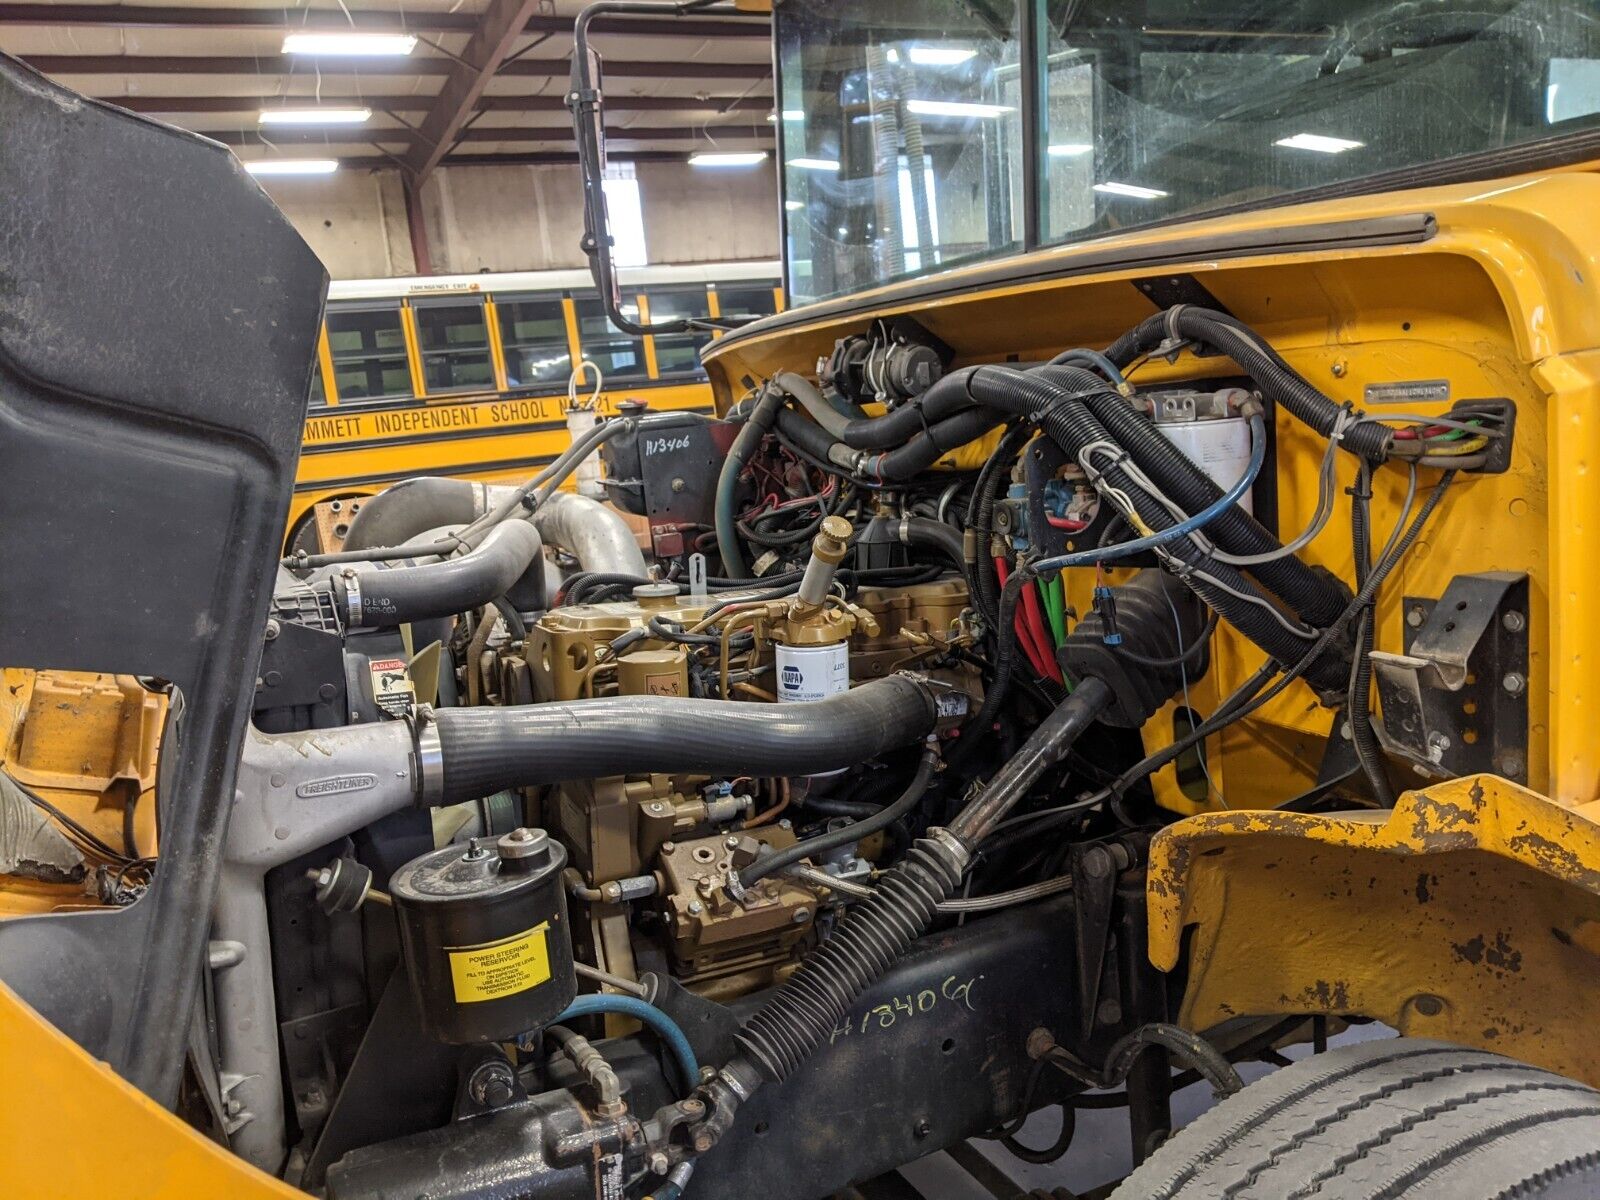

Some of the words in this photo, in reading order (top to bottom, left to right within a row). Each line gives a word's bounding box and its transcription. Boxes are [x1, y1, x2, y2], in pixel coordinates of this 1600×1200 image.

[303, 417, 361, 440] MMETT
[374, 406, 478, 433] INDEPENDENT
[491, 401, 549, 423] SCHOOL
[783, 672, 799, 684] NAPA
[304, 777, 370, 794] FREIGHTLINER
[469, 954, 495, 963] POWER
[496, 943, 529, 958] STEERING
[481, 953, 520, 967] RESERVOIR
[486, 961, 521, 975] APPROPRIATE
